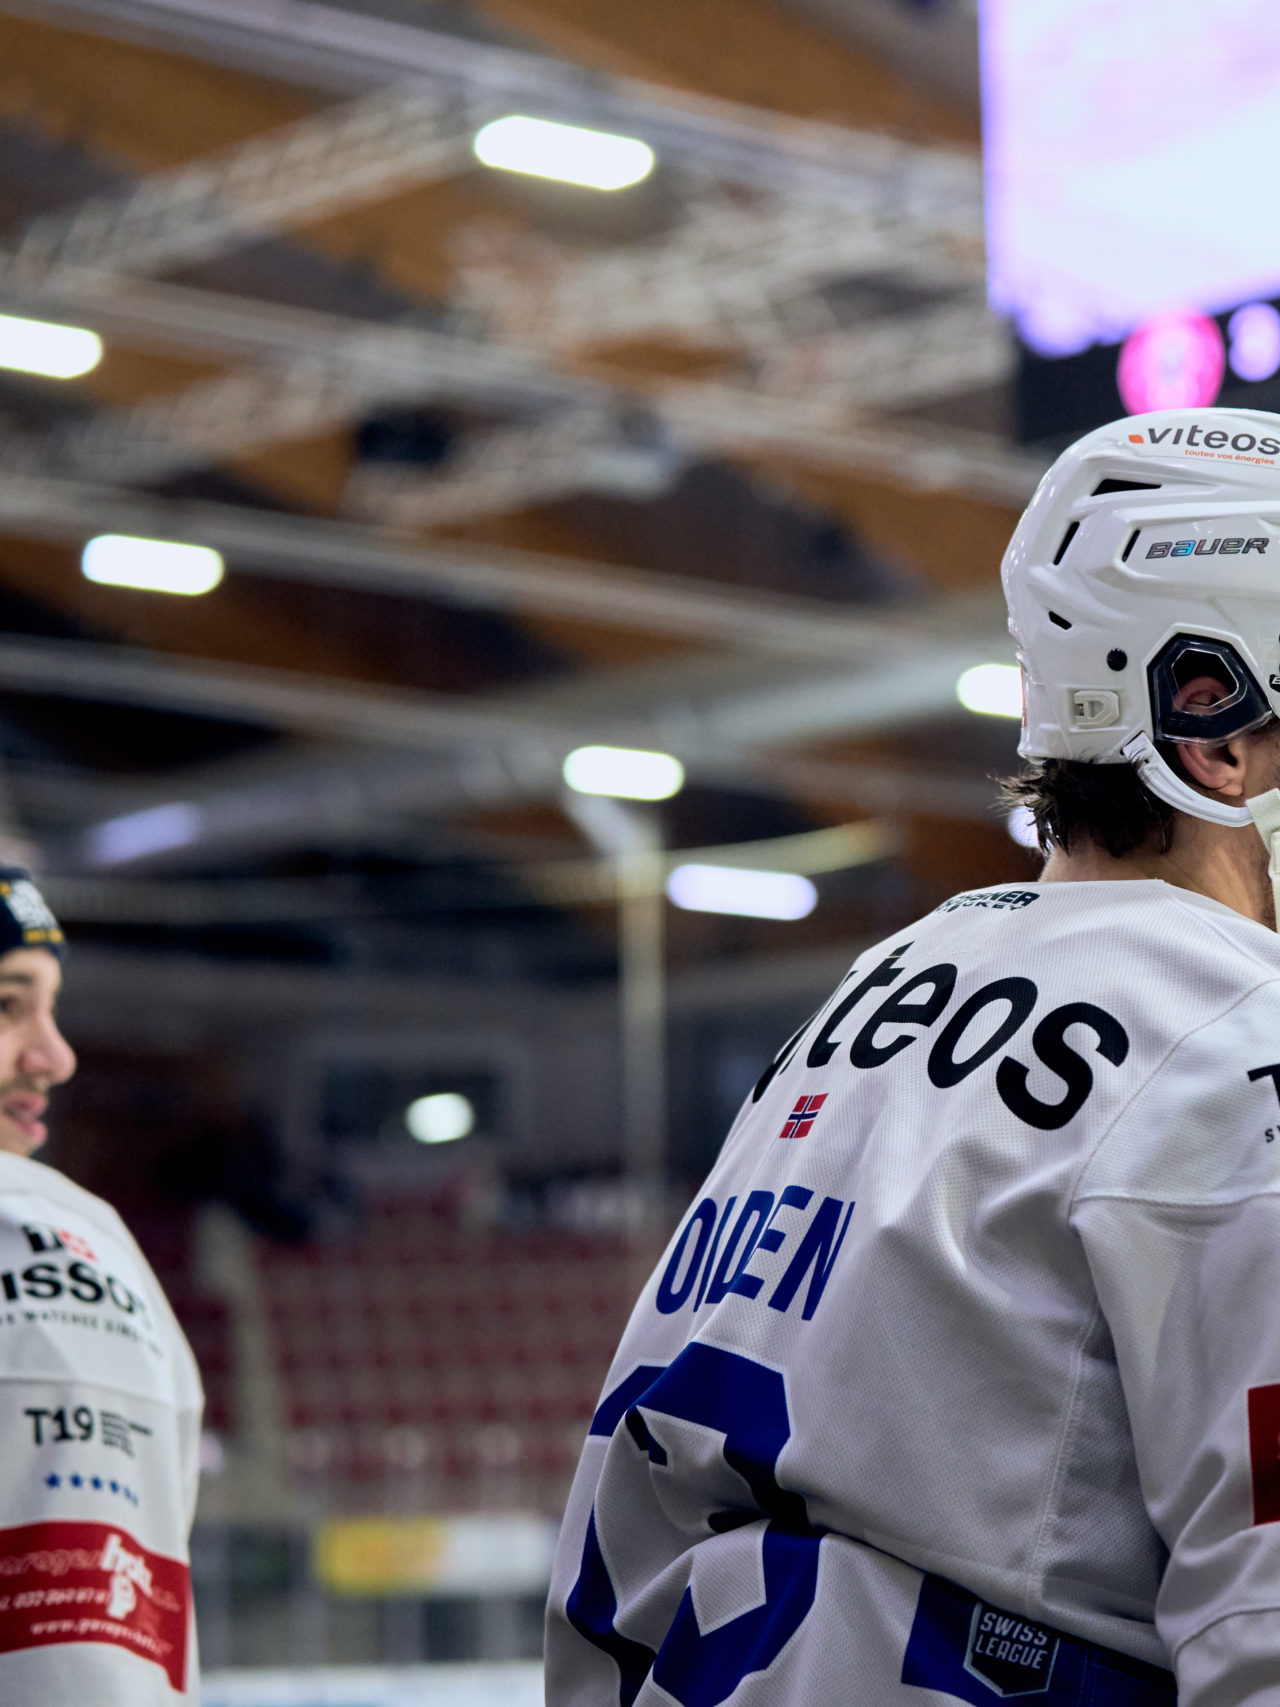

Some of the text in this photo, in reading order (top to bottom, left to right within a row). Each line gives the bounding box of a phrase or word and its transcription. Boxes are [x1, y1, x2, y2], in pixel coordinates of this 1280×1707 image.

[1184, 449, 1215, 458] toutes
[1145, 537, 1270, 560] BAUER
[24, 1405, 94, 1447] T19
[980, 1612, 1050, 1647] SWISS
[975, 1634, 1049, 1670] LEAGUE
